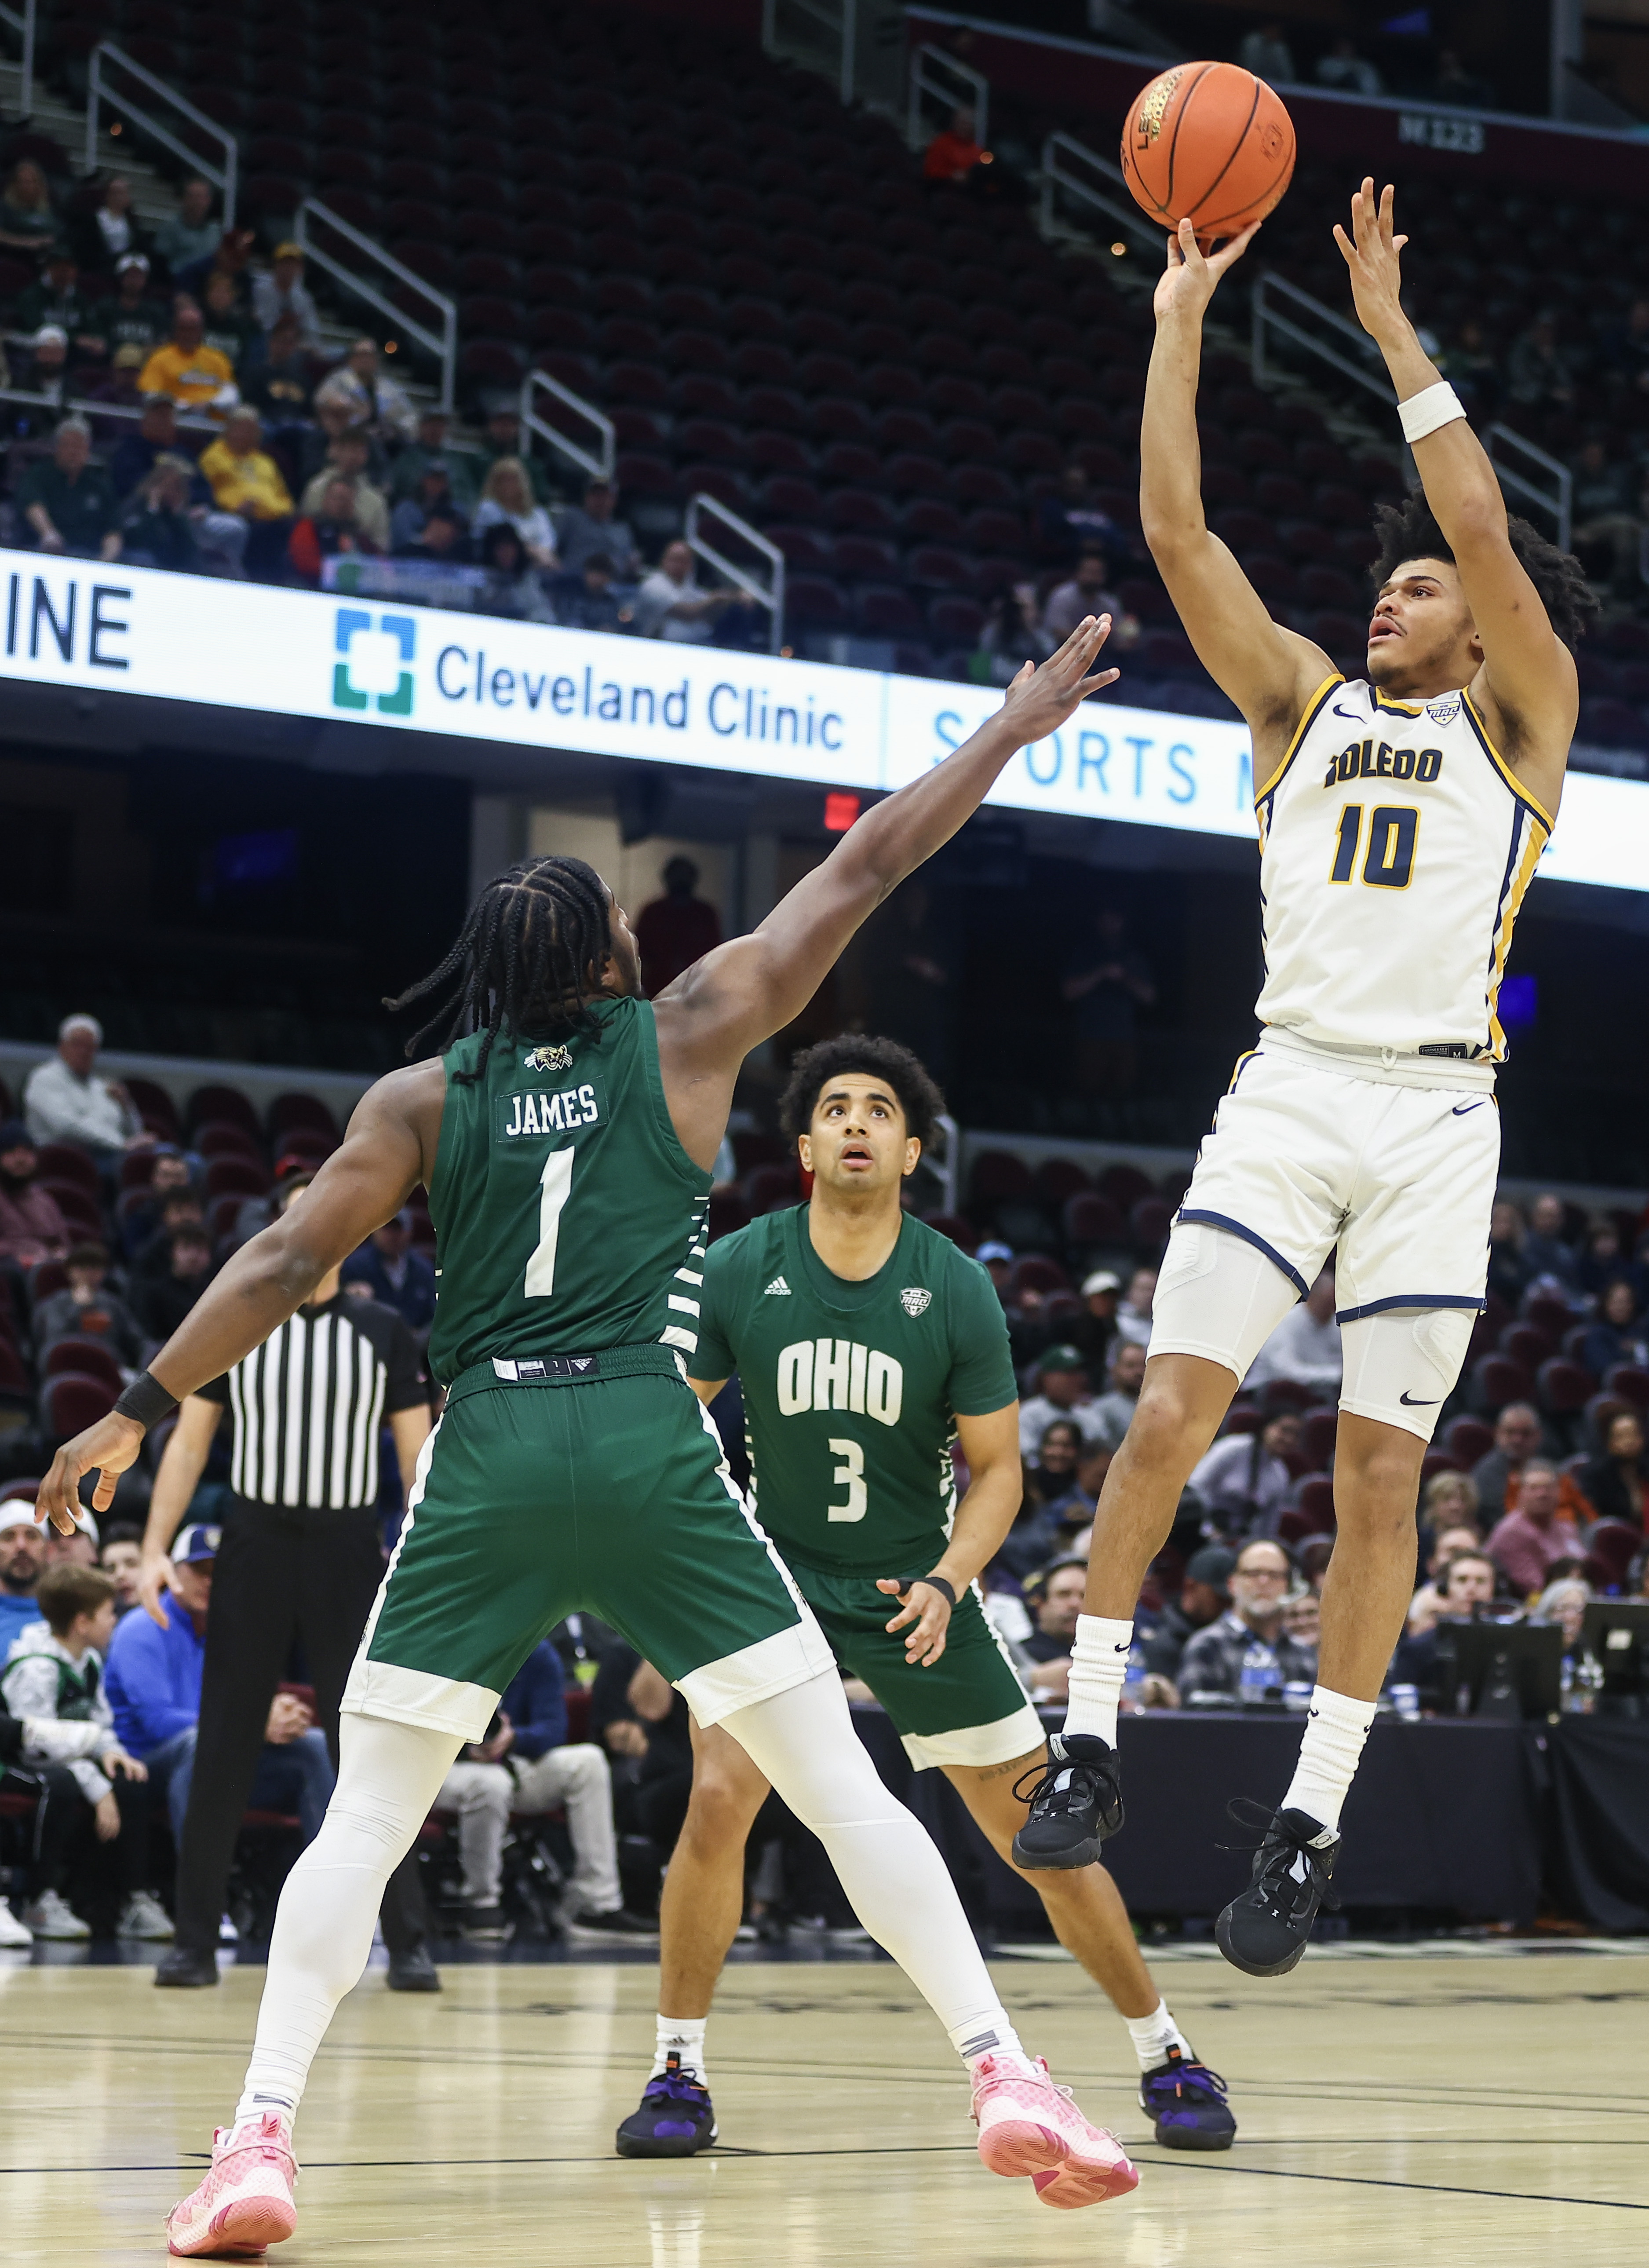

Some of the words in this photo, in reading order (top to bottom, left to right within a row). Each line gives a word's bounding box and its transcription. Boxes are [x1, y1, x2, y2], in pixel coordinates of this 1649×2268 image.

[6, 572, 132, 669] INE
[437, 645, 689, 729] Cleveland
[708, 683, 843, 750] Clinic
[1430, 706, 1459, 717] MAC
[933, 710, 1198, 805] SORTS
[1328, 803, 1421, 891] 10
[506, 1084, 598, 1136] JAMES
[524, 1145, 575, 1299] 1
[901, 1296, 929, 1307] MAC
[777, 1337, 904, 1427] OHIO
[827, 1437, 867, 1523] 3
